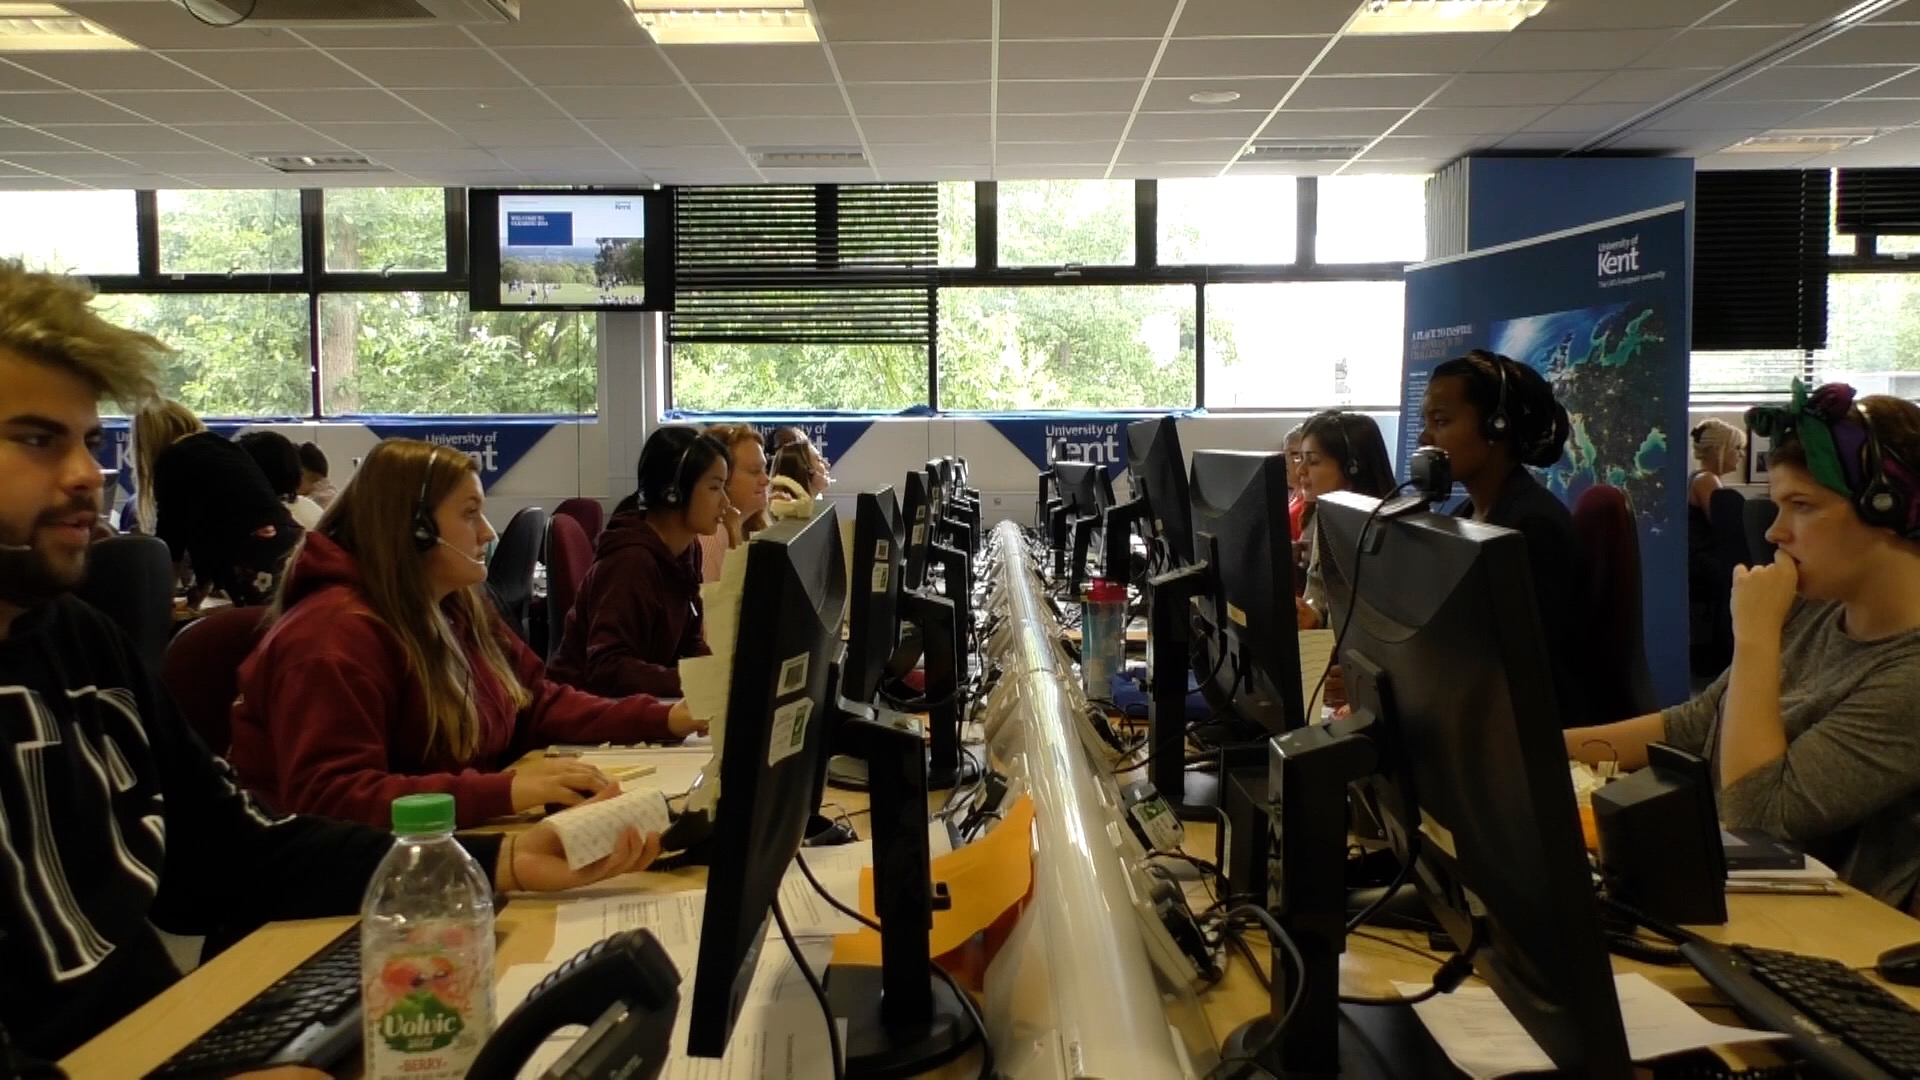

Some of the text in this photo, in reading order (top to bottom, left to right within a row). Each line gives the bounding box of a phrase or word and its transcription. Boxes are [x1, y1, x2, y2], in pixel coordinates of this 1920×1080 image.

[1598, 238, 1630, 252] University
[1598, 247, 1639, 276] Kent
[814, 421, 828, 435] of
[1045, 422, 1119, 438] University of
[425, 431, 498, 446] University of
[384, 1012, 457, 1038] Volvic
[404, 1056, 443, 1072] BERRY
